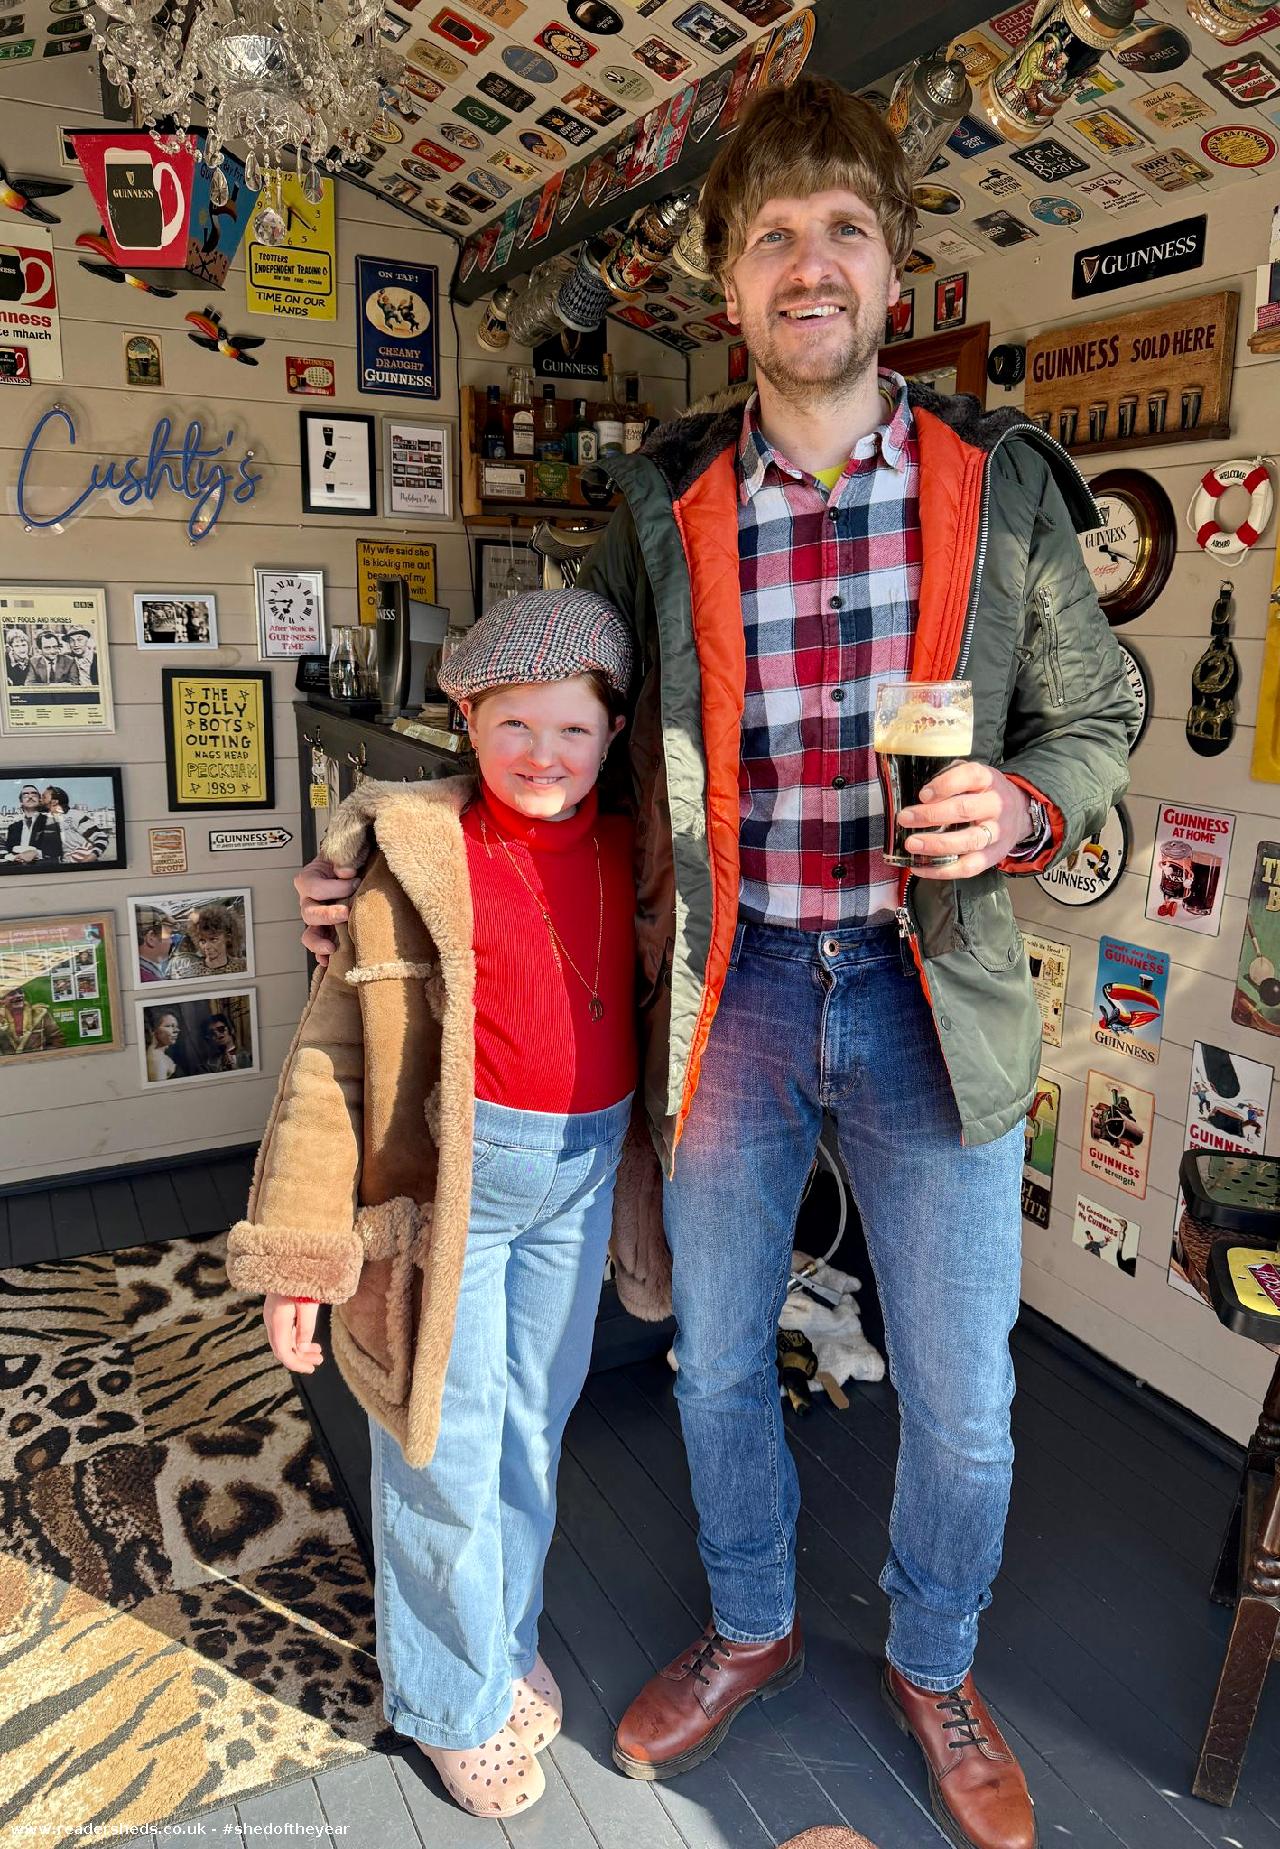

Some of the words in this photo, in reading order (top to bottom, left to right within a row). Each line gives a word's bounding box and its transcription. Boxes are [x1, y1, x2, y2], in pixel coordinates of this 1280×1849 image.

[1139, 156, 1169, 172] WHY
[112, 188, 154, 199] GUINNESS
[258, 252, 289, 265] TROTTERS
[1100, 234, 1198, 276] GUINNESS
[254, 263, 295, 275] INDEPENDENT
[378, 270, 393, 279] ON
[256, 291, 282, 304] TIME
[284, 294, 301, 305] ON
[303, 296, 326, 308] OUR
[273, 305, 309, 317] HANDS
[1032, 334, 1120, 383] GUINNESS
[1130, 333, 1170, 364] SOLD
[1171, 324, 1217, 356] HERE
[375, 357, 425, 371] DRAUGHT
[541, 358, 599, 377] GUINNESS
[364, 368, 432, 388] GUINNESS
[17, 409, 263, 541] Cushty's
[1219, 469, 1247, 480] WELCOME
[1085, 524, 1127, 549] GUINNESS
[363, 544, 376, 555] My
[376, 545, 395, 554] wife
[395, 546, 413, 555] said
[414, 548, 430, 557] she
[372, 558, 401, 570] kicking
[417, 562, 431, 570] out
[413, 575, 426, 584] my
[2, 616, 16, 624] ONLY
[17, 616, 36, 624] FOOLS
[37, 616, 50, 624] AND
[50, 616, 72, 624] HORSES
[268, 632, 317, 641] GUINNESS
[201, 687, 228, 701] THE
[184, 700, 247, 718] JOLLY
[199, 718, 243, 733] BOYS
[185, 734, 252, 749] OUTING
[194, 750, 221, 760] NAGS
[224, 750, 249, 760] HEAD
[186, 762, 258, 779] PECKHAM
[207, 781, 237, 795] 1989
[1163, 808, 1230, 834] GUINNESS
[215, 833, 268, 844] GUINNESS
[1172, 827, 1185, 838] AT
[1186, 830, 1216, 844] HOME
[1042, 868, 1097, 893] GUINNESS
[1104, 948, 1164, 975] GUINNESS
[1094, 1030, 1156, 1064] GUINNESS
[1089, 1147, 1140, 1179] GUINNESS
[1090, 1160, 1102, 1171] for
[1104, 1167, 1136, 1187] strength
[1087, 1214, 1118, 1237] GUINNESS
